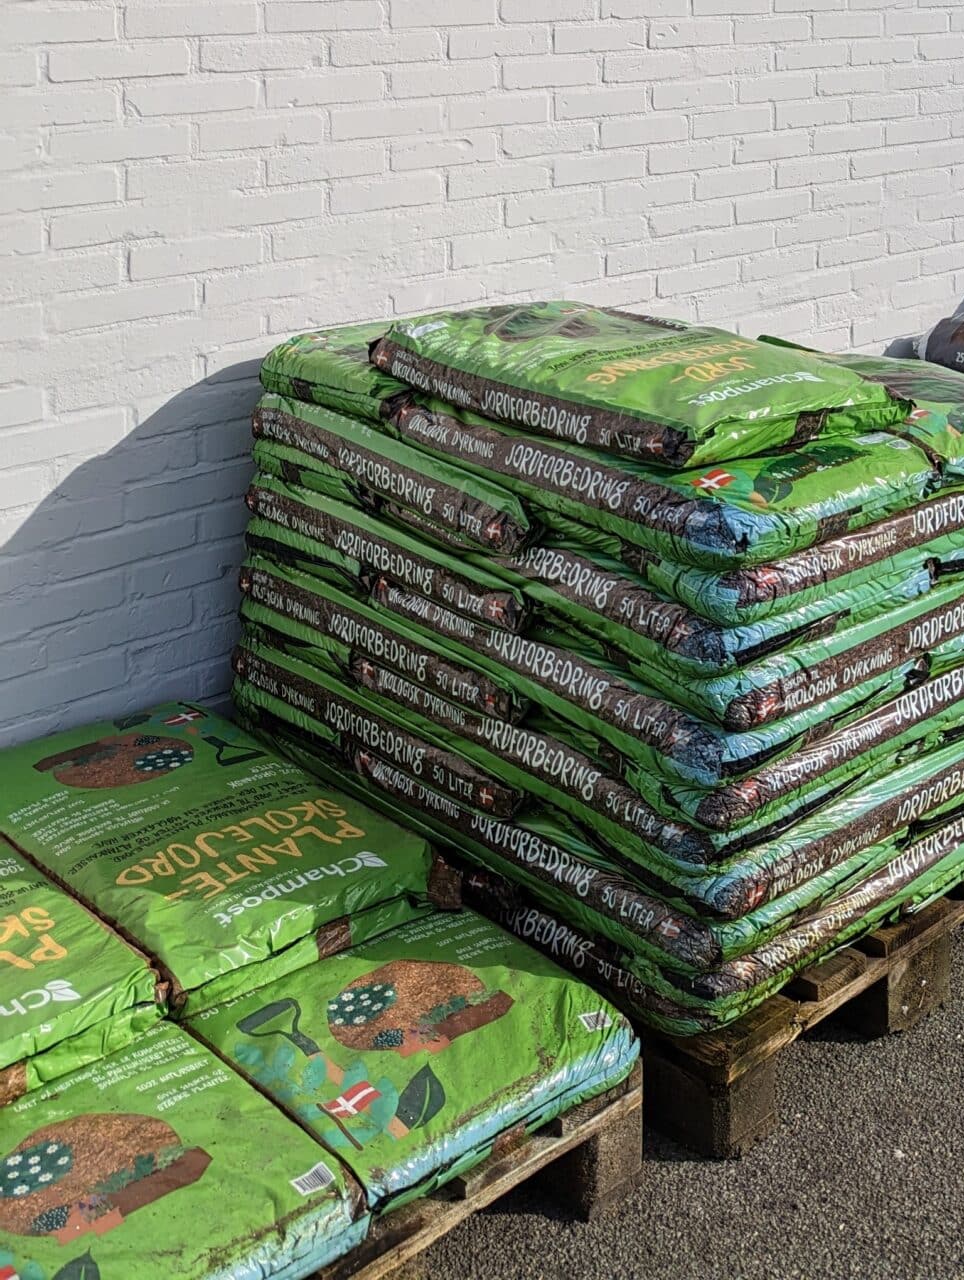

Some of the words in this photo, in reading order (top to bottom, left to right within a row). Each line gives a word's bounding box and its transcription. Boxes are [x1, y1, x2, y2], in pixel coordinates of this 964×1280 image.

[688, 372, 803, 407] Champost
[956, 351, 964, 363] 25
[481, 388, 591, 443] JORDFORBEDRING
[599, 427, 611, 447] 50
[451, 430, 495, 459] DYRKNING
[505, 444, 629, 509] JORDFORBEDRING
[633, 495, 649, 515] 50
[443, 503, 455, 519] 50
[335, 529, 434, 595] JORDFORBEDRING
[442, 584, 456, 600] 50
[848, 529, 897, 561] DYRKNING
[619, 597, 635, 619] 50
[328, 614, 428, 681] JORDFORBEDRING
[436, 670, 449, 687] 50
[486, 629, 610, 710] JORDFORBEDRING
[614, 701, 630, 721] 50
[843, 651, 892, 686] DYRKNING
[324, 700, 426, 775] JORDFORBEDRING
[432, 765, 445, 783] 50
[379, 670, 420, 704] ØKOLOGISK
[424, 691, 466, 726] DYRKNING
[476, 716, 601, 801] JORDFORBEDRING
[606, 791, 621, 815] 50
[116, 799, 346, 887] SKOLEJORD
[164, 820, 366, 901] PLANTE-
[213, 853, 365, 928] Champost
[602, 886, 616, 909] 50
[598, 959, 615, 980] 50
